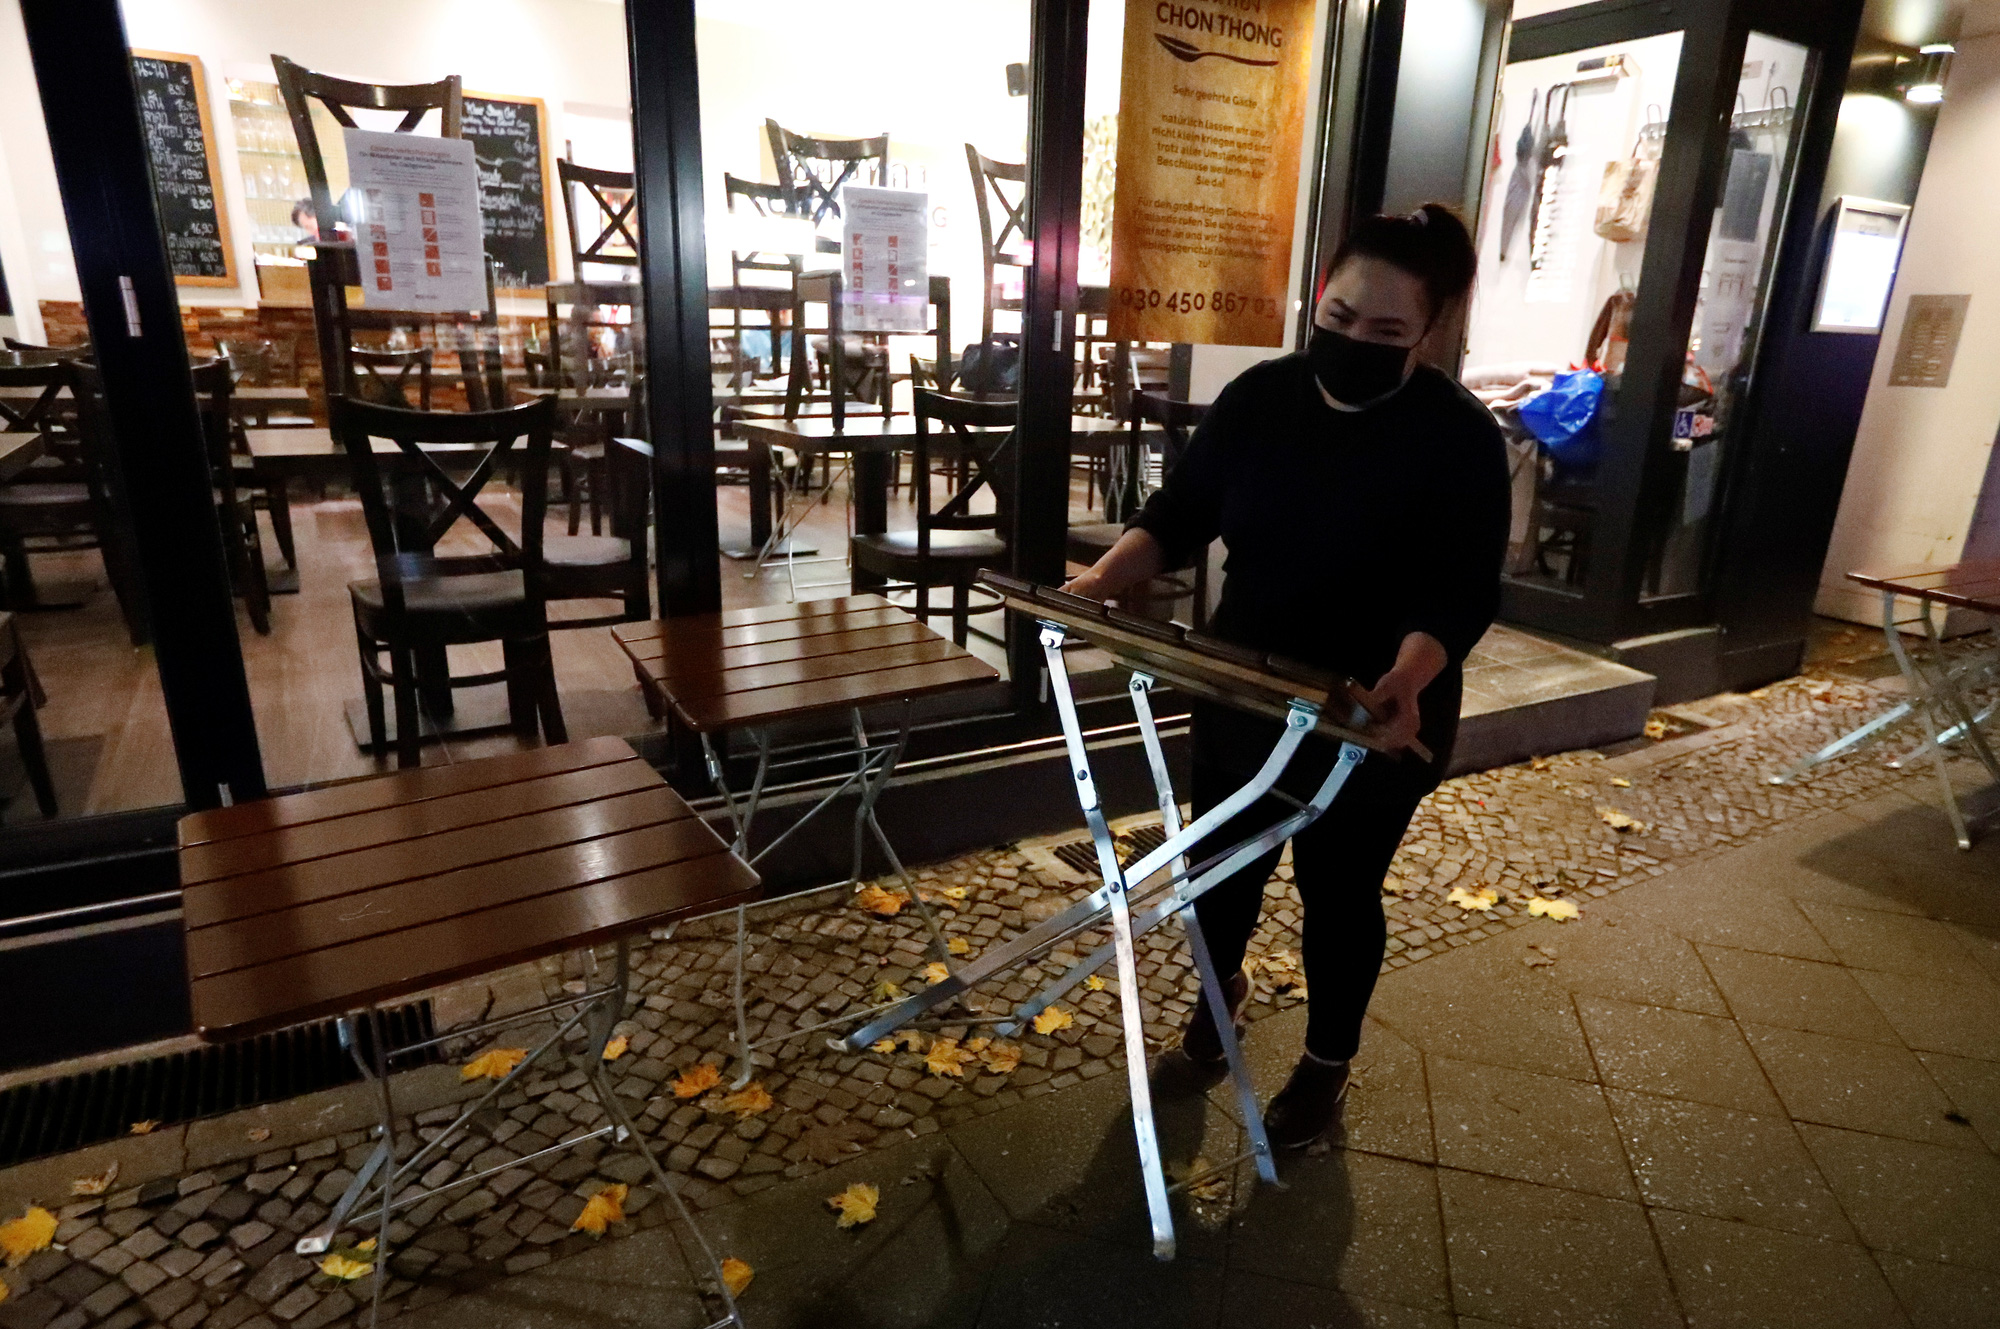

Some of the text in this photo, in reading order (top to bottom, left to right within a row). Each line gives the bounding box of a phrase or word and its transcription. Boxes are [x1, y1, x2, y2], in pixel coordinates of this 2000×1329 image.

[1156, 2, 1282, 48] CHON THONG
[1173, 84, 1258, 109] Sehr geehrte Gäste
[1161, 113, 1204, 128] natürlich
[1205, 119, 1234, 132] lassen
[1151, 126, 1176, 138] nicht
[1177, 131, 1200, 142] klein
[1201, 133, 1235, 148] kriegen
[1236, 140, 1253, 150] und
[1156, 141, 1179, 153] trotz
[1156, 154, 1209, 172] Beschlüsse
[1195, 175, 1210, 186] Sie
[1153, 199, 1173, 210] den
[1178, 216, 1204, 227] rufen
[1204, 218, 1218, 229] Sie
[1185, 232, 1203, 241] und
[1121, 287, 1278, 320] 030 450 867 03
